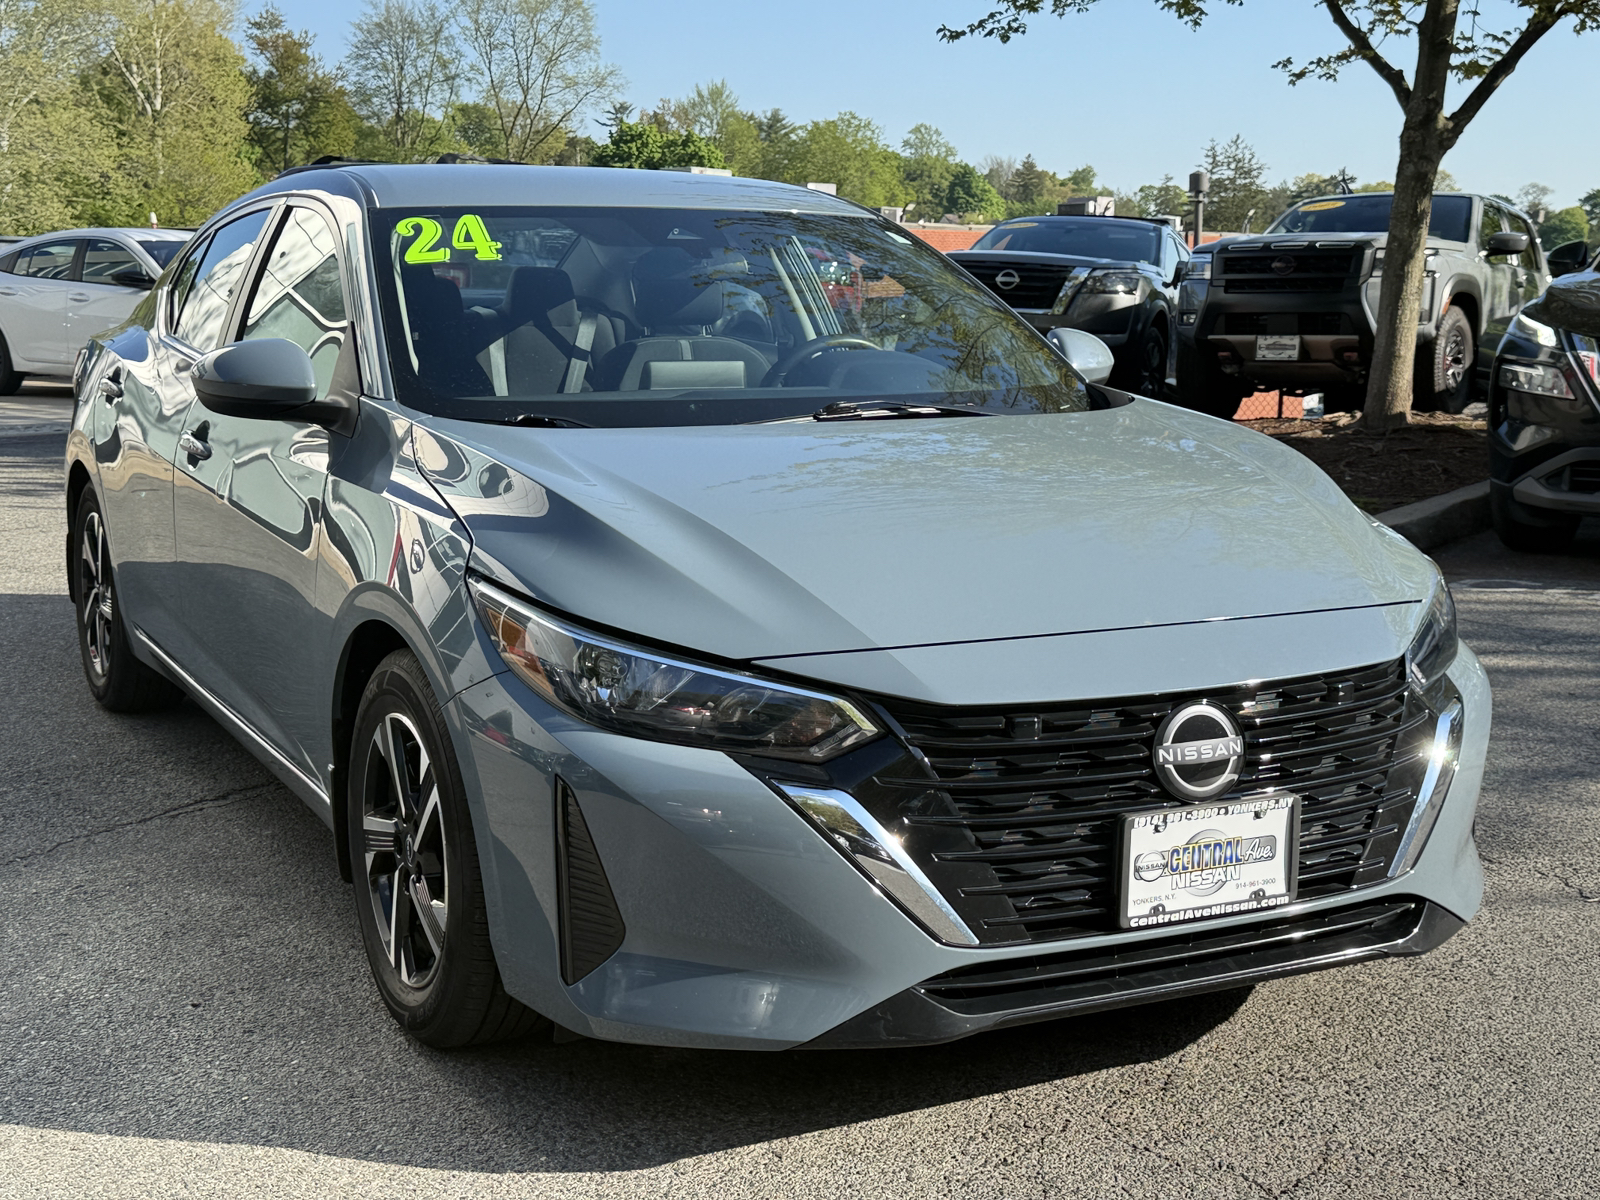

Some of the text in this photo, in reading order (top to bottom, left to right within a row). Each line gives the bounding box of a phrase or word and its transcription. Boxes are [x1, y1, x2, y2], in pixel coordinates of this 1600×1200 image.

[396, 213, 502, 265] 24
[1158, 739, 1242, 763] NISSAN
[1137, 862, 1165, 871] NISSAN
[1168, 836, 1273, 875] CENTRAL Ave.
[1171, 865, 1241, 890] NISSAN
